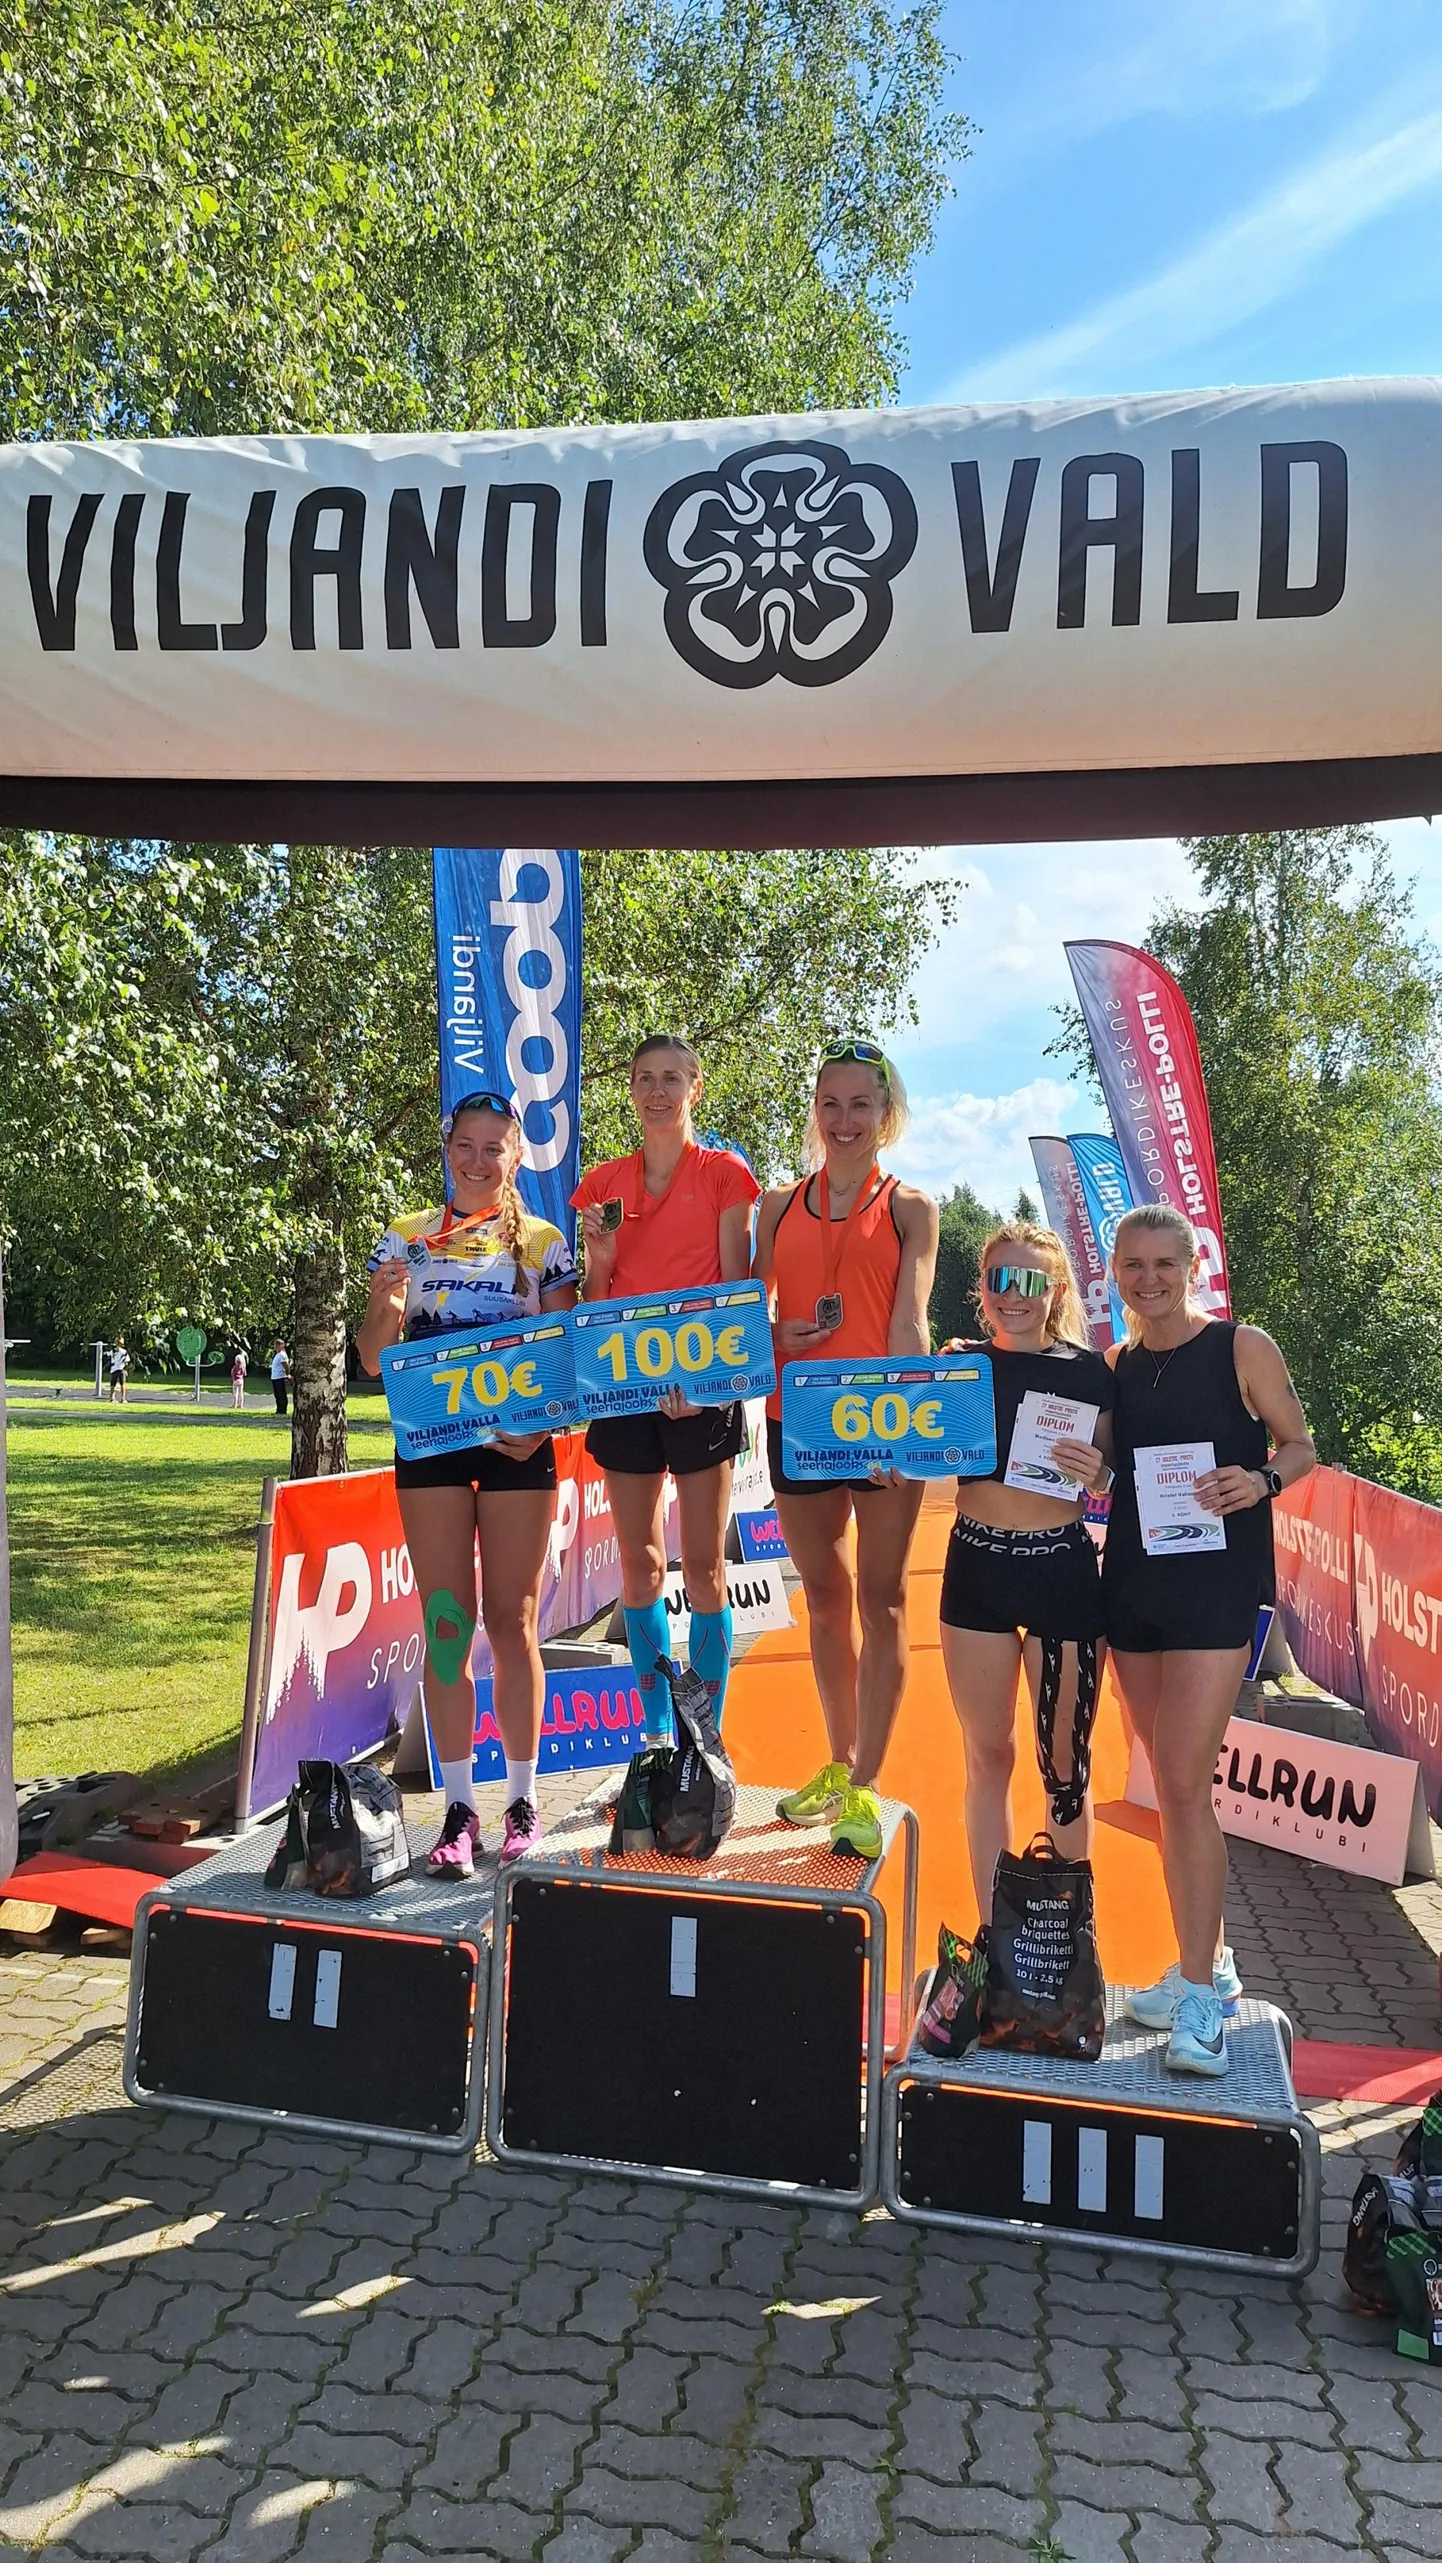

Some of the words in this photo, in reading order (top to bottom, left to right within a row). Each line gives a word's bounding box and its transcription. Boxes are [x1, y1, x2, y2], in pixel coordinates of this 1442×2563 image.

[25, 479, 613, 652] VILJANDI
[952, 440, 1348, 633] VALD
[598, 1322, 749, 1382] 100€
[432, 1360, 543, 1415] 70€
[693, 1379, 731, 1394] VILJANDI
[749, 1374, 772, 1387] VALD
[582, 1388, 638, 1405] VILJANDI
[511, 1406, 547, 1423] VILJANDI
[586, 1398, 657, 1416] seeriajooks.
[407, 1421, 461, 1442] VILJANDI
[463, 1413, 501, 1430] VALLA
[831, 1393, 945, 1442] 60€
[1036, 1415, 1075, 1433] DIPLOM
[795, 1449, 851, 1463] VILJANDI
[851, 1448, 894, 1461] VALLA
[906, 1450, 944, 1463] VILJANDI
[963, 1449, 985, 1460] VALD
[1157, 1470, 1198, 1485] DIPLOM
[584, 1479, 612, 1521] HOL
[381, 1543, 419, 1604] HO
[1381, 1571, 1442, 1655] HOLST
[366, 1633, 426, 1690] SPO
[1381, 1664, 1440, 1748] SPORD
[1213, 1743, 1378, 1829] ELLRUN
[1214, 1797, 1367, 1853] RDIKLUBI
[1021, 1924, 1071, 1942] briquettes
[1027, 1917, 1069, 1930] Charcoal
[1013, 1938, 1074, 1956] Grillibriketti
[1014, 1952, 1070, 1971] Grillbrikett
[1016, 1968, 1028, 1979] 10
[1040, 1973, 1054, 1984] 2.5
